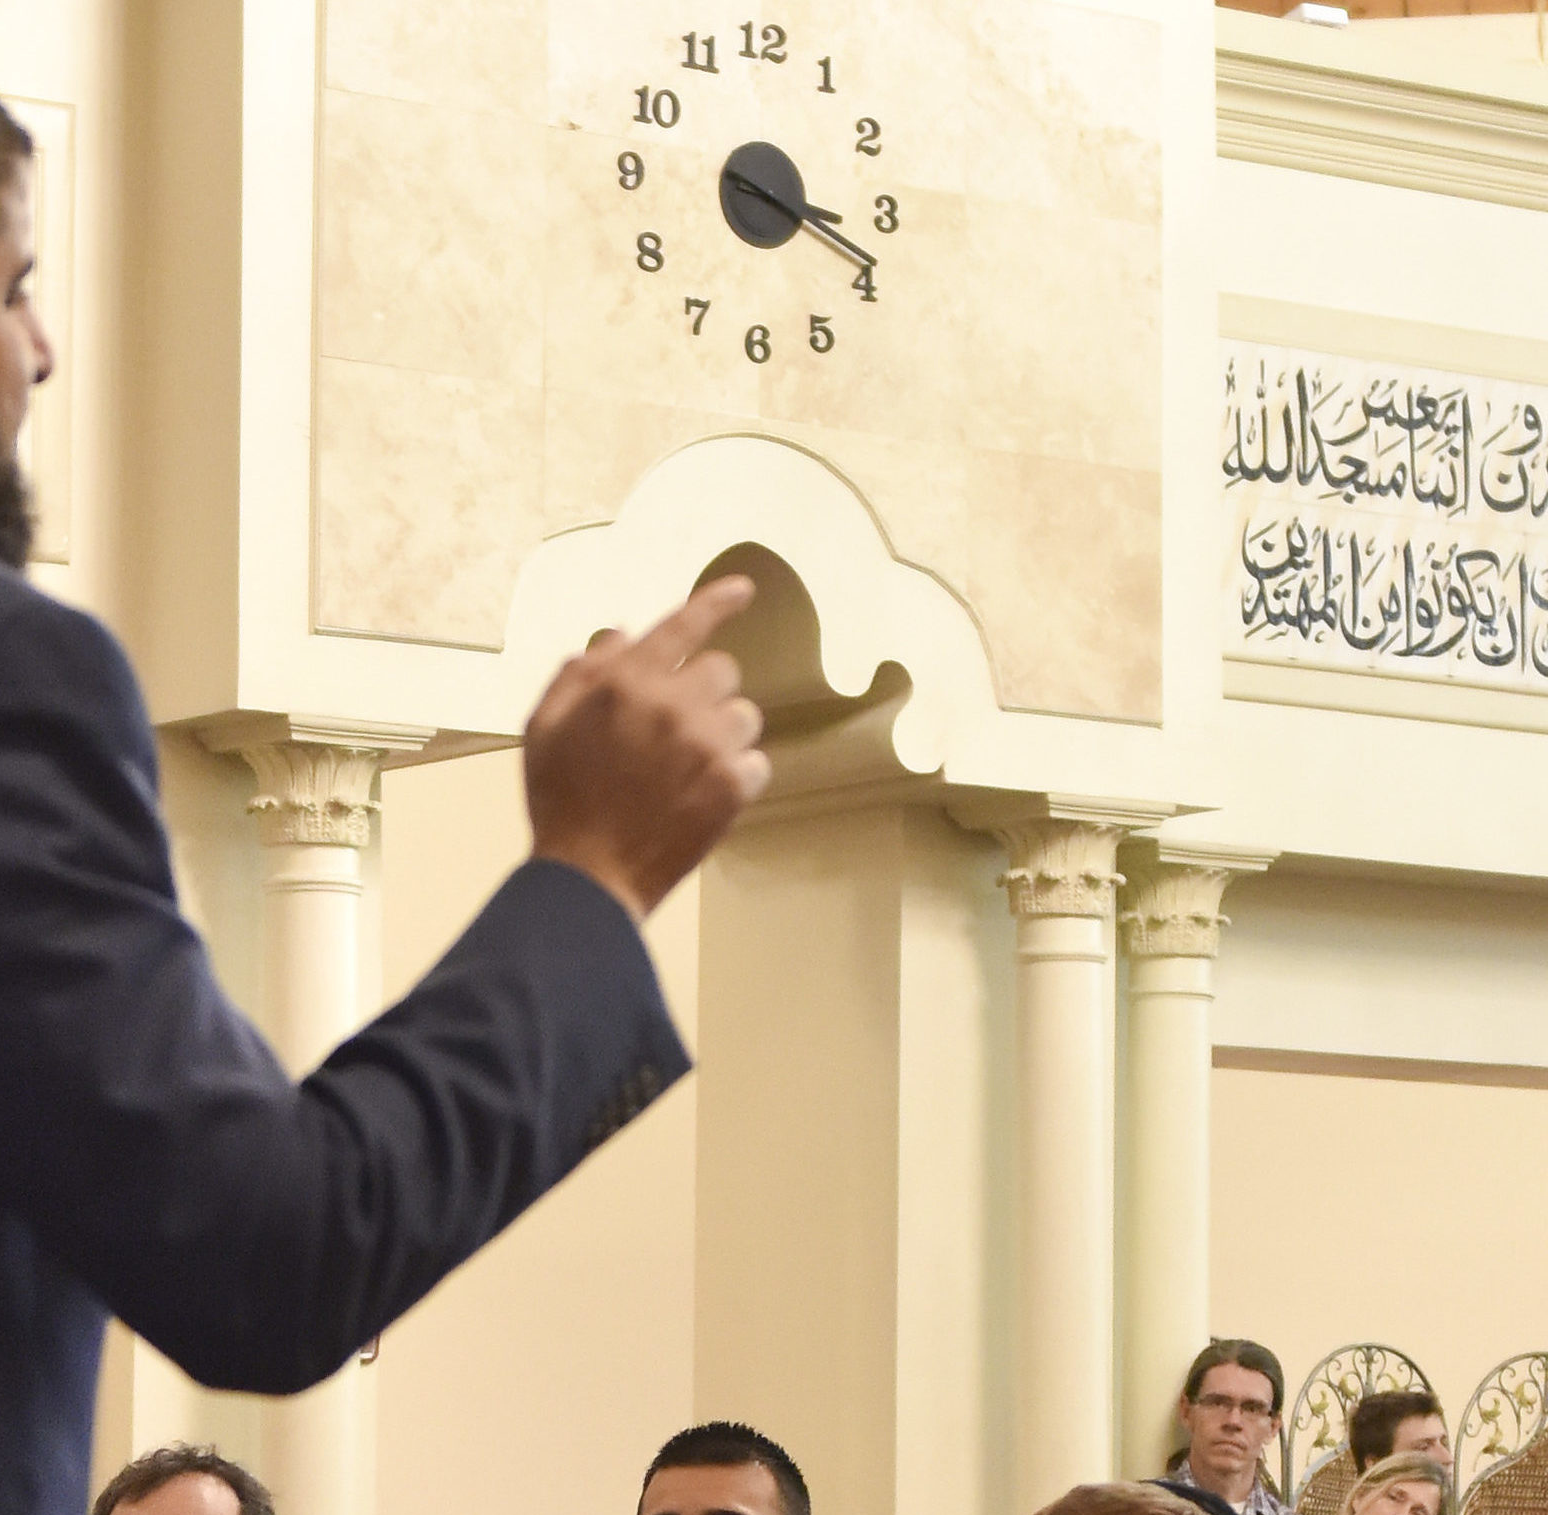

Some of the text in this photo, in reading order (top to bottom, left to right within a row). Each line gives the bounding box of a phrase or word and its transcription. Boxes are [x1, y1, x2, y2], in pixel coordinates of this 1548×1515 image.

[681, 31, 719, 74] 11
[738, 21, 788, 64] 12
[817, 56, 836, 94] 1
[633, 85, 681, 129] 10
[854, 116, 882, 157] 2
[617, 151, 644, 191] 9
[873, 194, 900, 234] 3
[636, 231, 665, 273] 8
[851, 263, 878, 303] 4
[684, 296, 711, 336] 7
[808, 314, 835, 354] 5
[744, 324, 771, 364] 6
